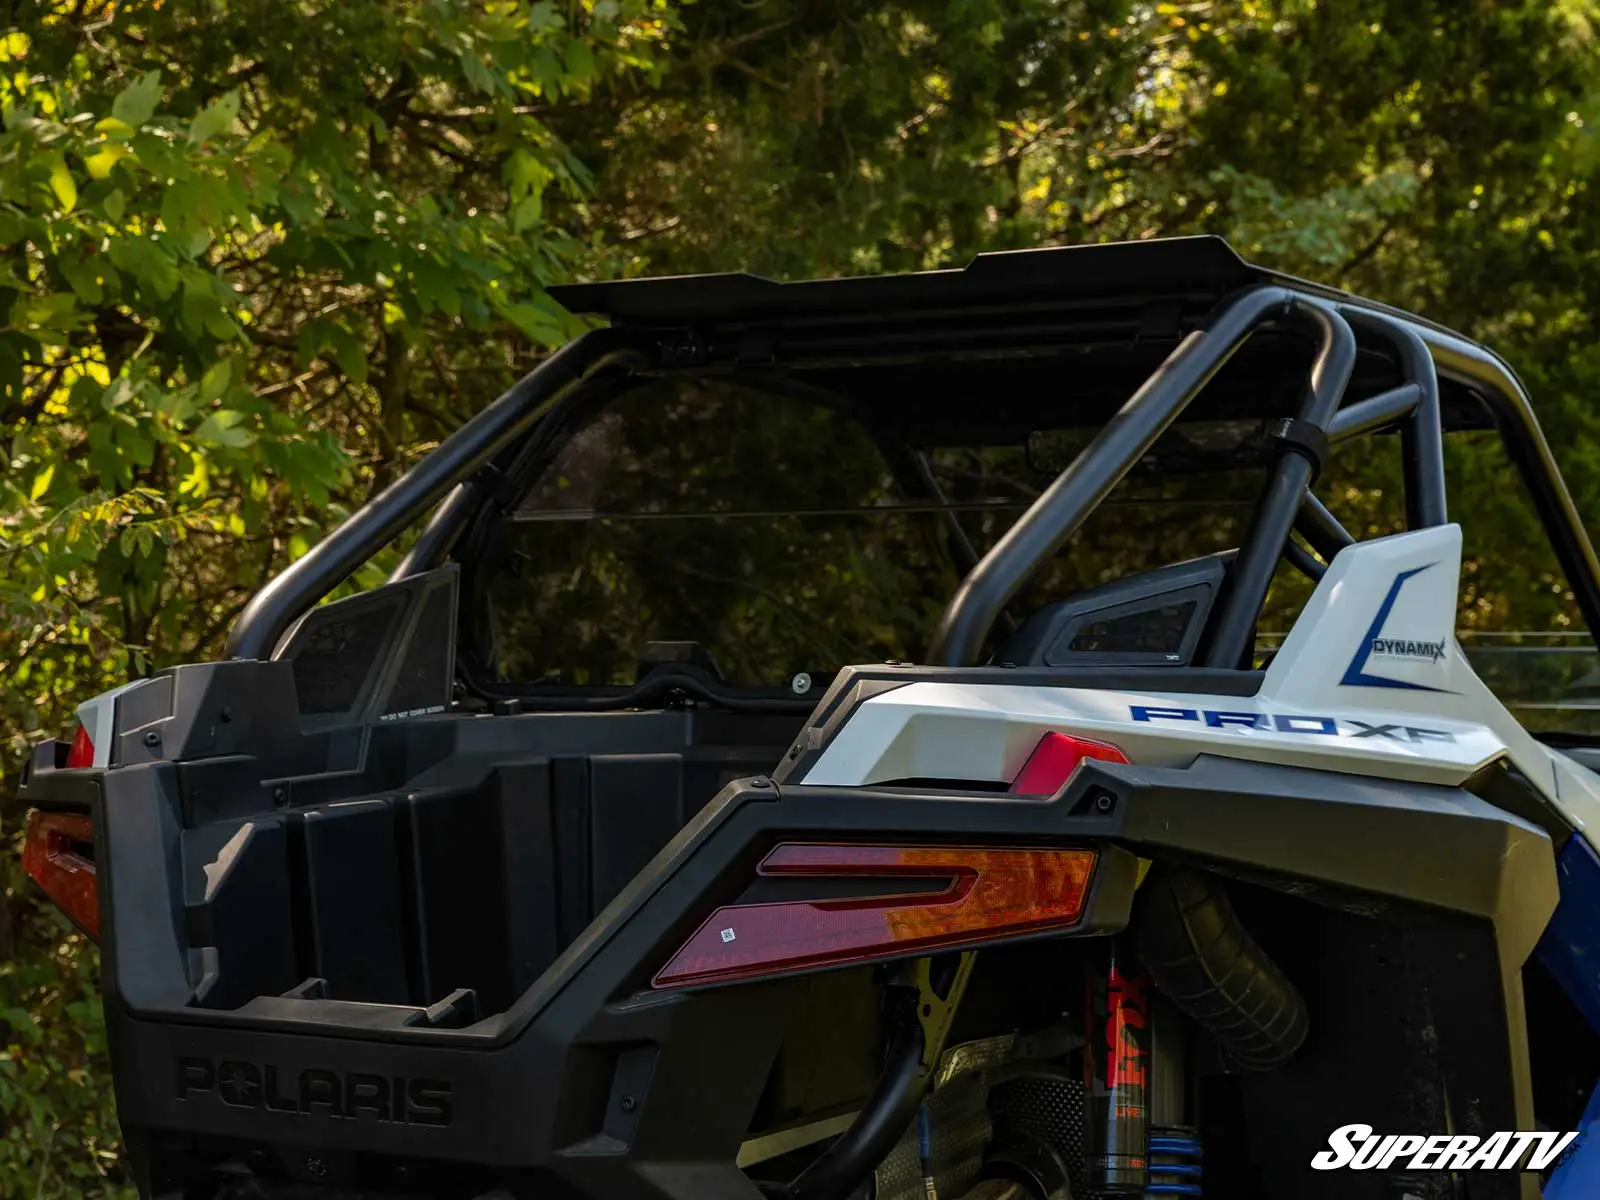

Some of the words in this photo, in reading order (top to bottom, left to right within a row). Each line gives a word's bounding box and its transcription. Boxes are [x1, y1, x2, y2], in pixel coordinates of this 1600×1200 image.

[1373, 637, 1446, 664] DYNAMIX
[1129, 705, 1339, 736] PRO
[174, 1056, 453, 1128] POLARIS
